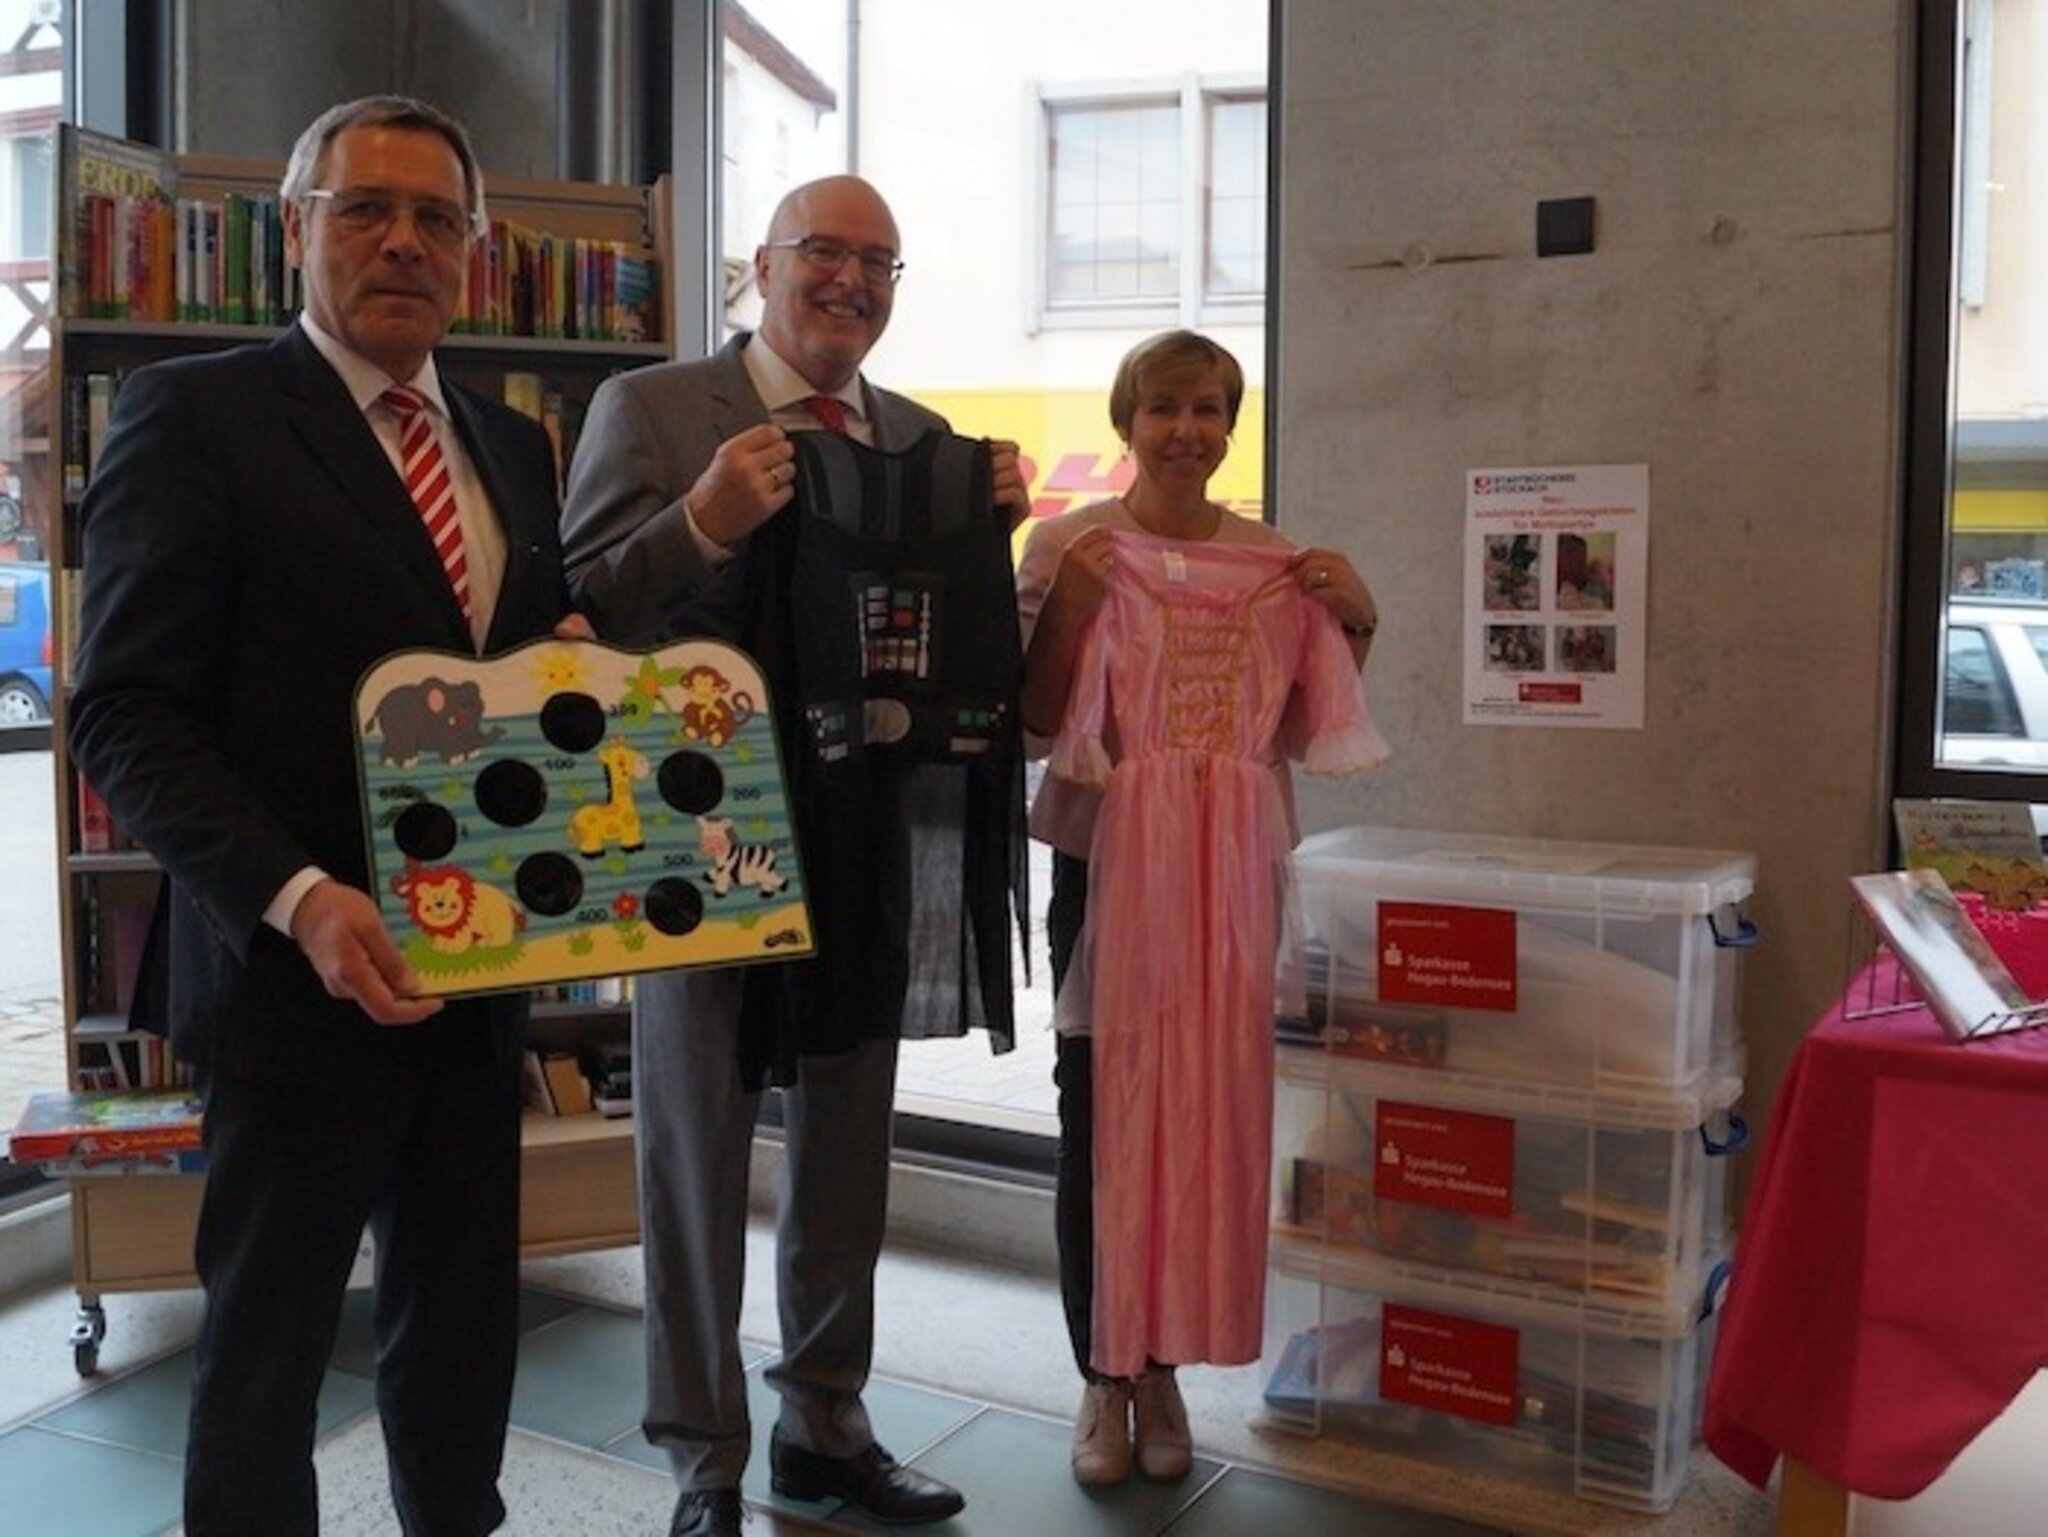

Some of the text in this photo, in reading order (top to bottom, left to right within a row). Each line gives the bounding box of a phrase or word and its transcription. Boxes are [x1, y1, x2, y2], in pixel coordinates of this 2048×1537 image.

[733, 787, 760, 801] 200
[663, 853, 694, 868] 500
[1407, 953, 1471, 972] Sparkasse
[1404, 1153, 1467, 1175] Sparkasse
